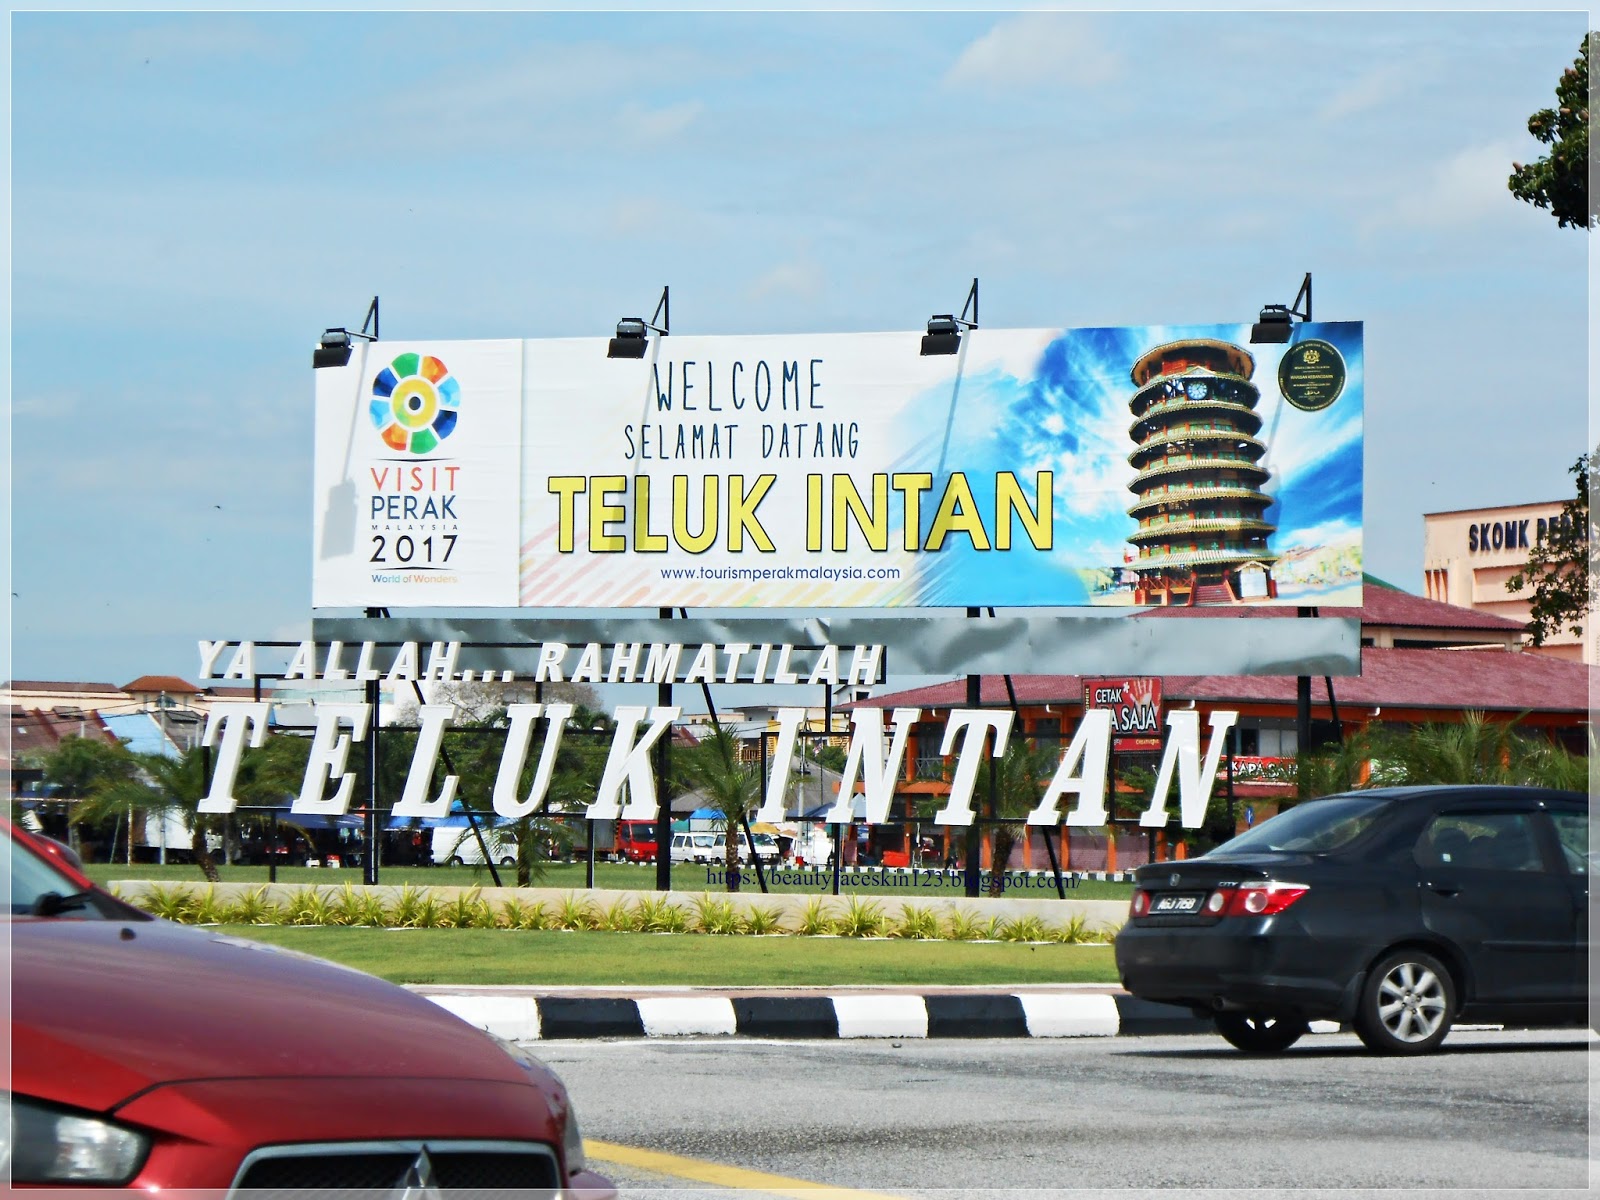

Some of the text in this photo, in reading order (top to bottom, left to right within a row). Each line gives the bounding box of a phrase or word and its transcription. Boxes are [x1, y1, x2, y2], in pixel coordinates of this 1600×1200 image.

[653, 359, 824, 412] WELCOME
[624, 422, 859, 460] SELAMAT DATANG
[370, 466, 460, 491] VISIT
[371, 495, 458, 520] PERAK
[547, 470, 1053, 554] TELUK INTAN
[369, 534, 458, 563] 2017
[1469, 519, 1530, 552] SKOMK
[371, 574, 457, 584] World of Wonders
[660, 565, 900, 583] www.tourismperakmalaysia.com
[198, 640, 255, 679] YA
[534, 642, 884, 684] RAHMATILAH
[1095, 688, 1122, 703] CETAK
[1121, 706, 1157, 731] SAJA
[197, 702, 1239, 829] TELUK INTAN
